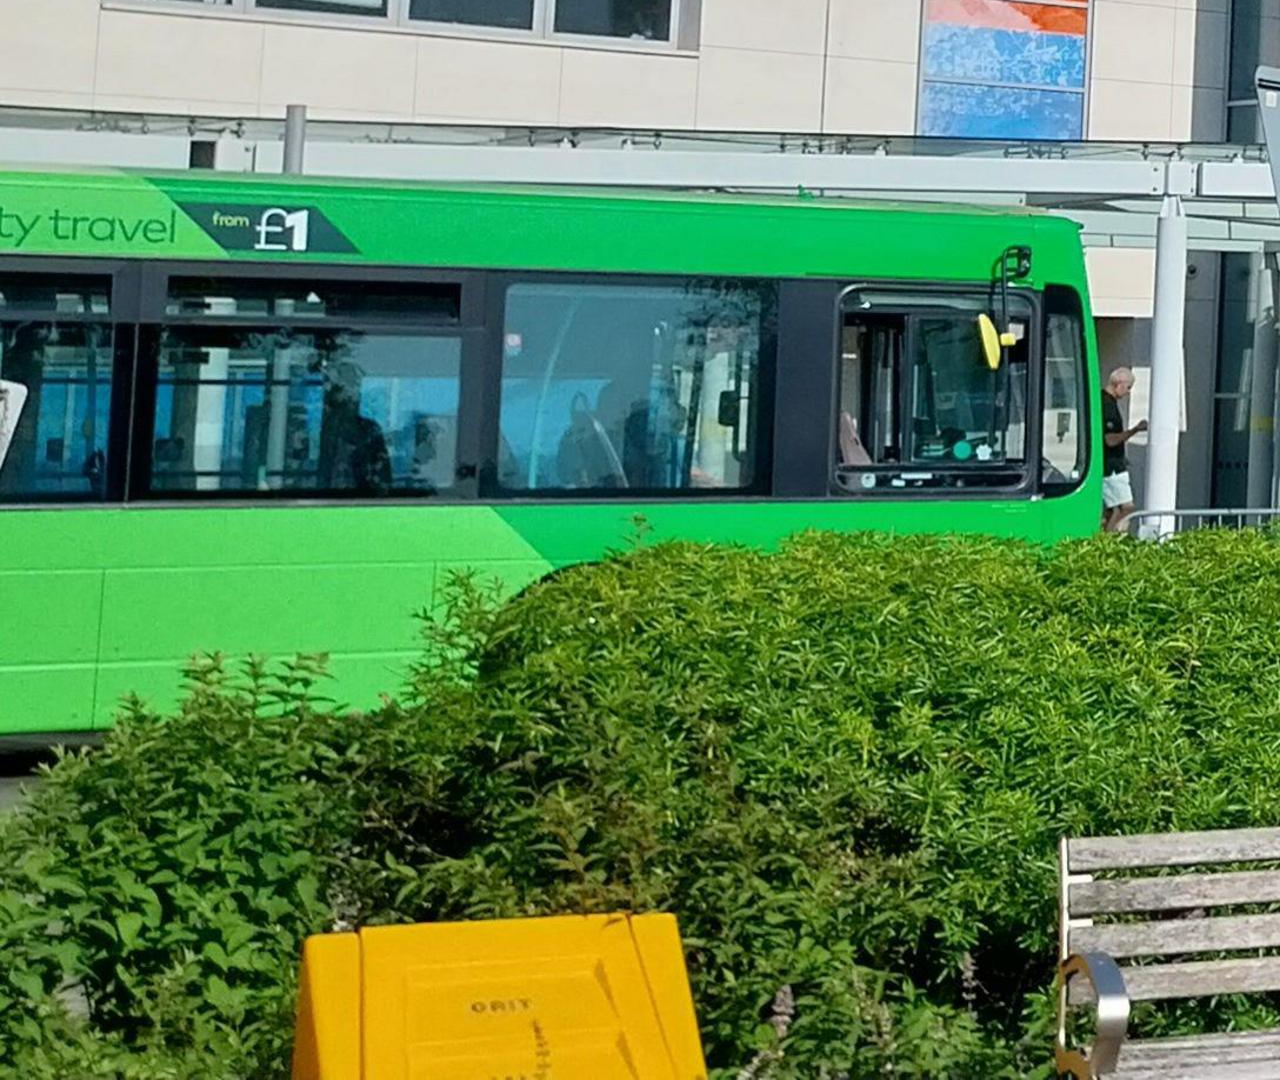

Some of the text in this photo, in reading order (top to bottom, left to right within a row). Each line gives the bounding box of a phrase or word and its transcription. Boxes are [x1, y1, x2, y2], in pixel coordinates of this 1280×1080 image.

[49, 209, 176, 244] travel
[213, 208, 309, 251] from £1
